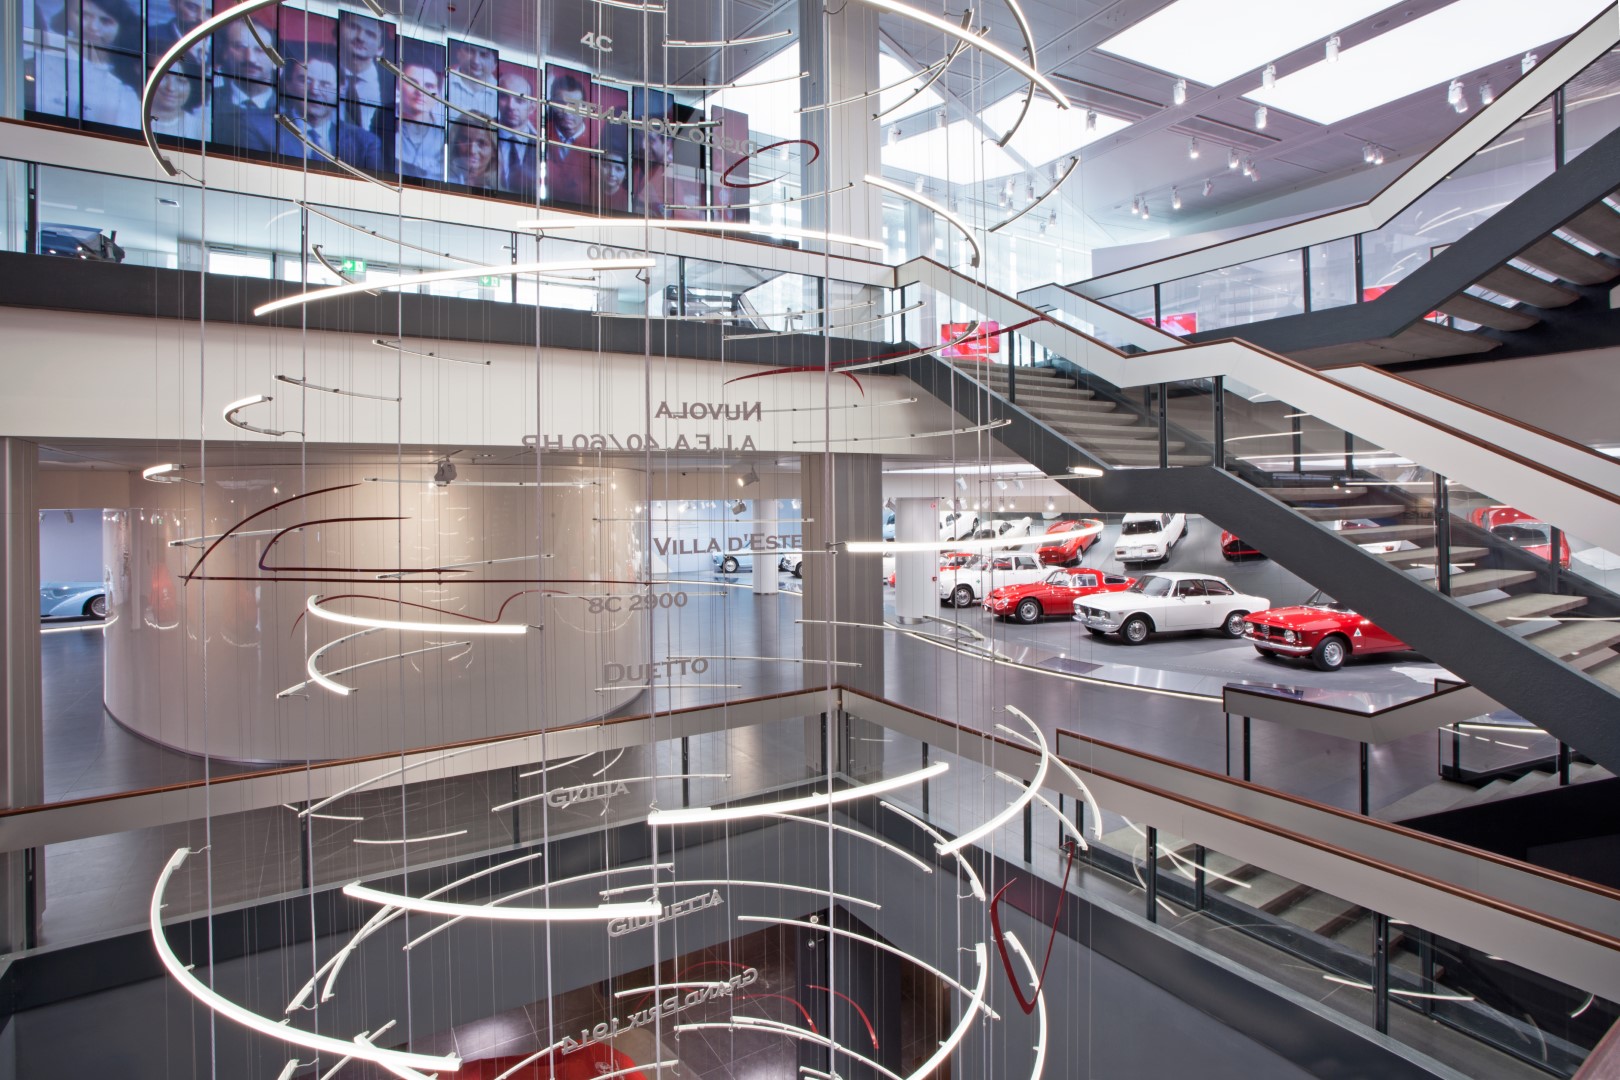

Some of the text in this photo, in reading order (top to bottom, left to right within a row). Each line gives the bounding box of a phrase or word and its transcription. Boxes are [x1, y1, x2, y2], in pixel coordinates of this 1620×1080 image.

[580, 32, 613, 52] 4C
[654, 537, 721, 556] VILLA
[588, 592, 688, 614] 8C 2900
[604, 658, 708, 684] DUETTO
[547, 781, 630, 808] GIULIA
